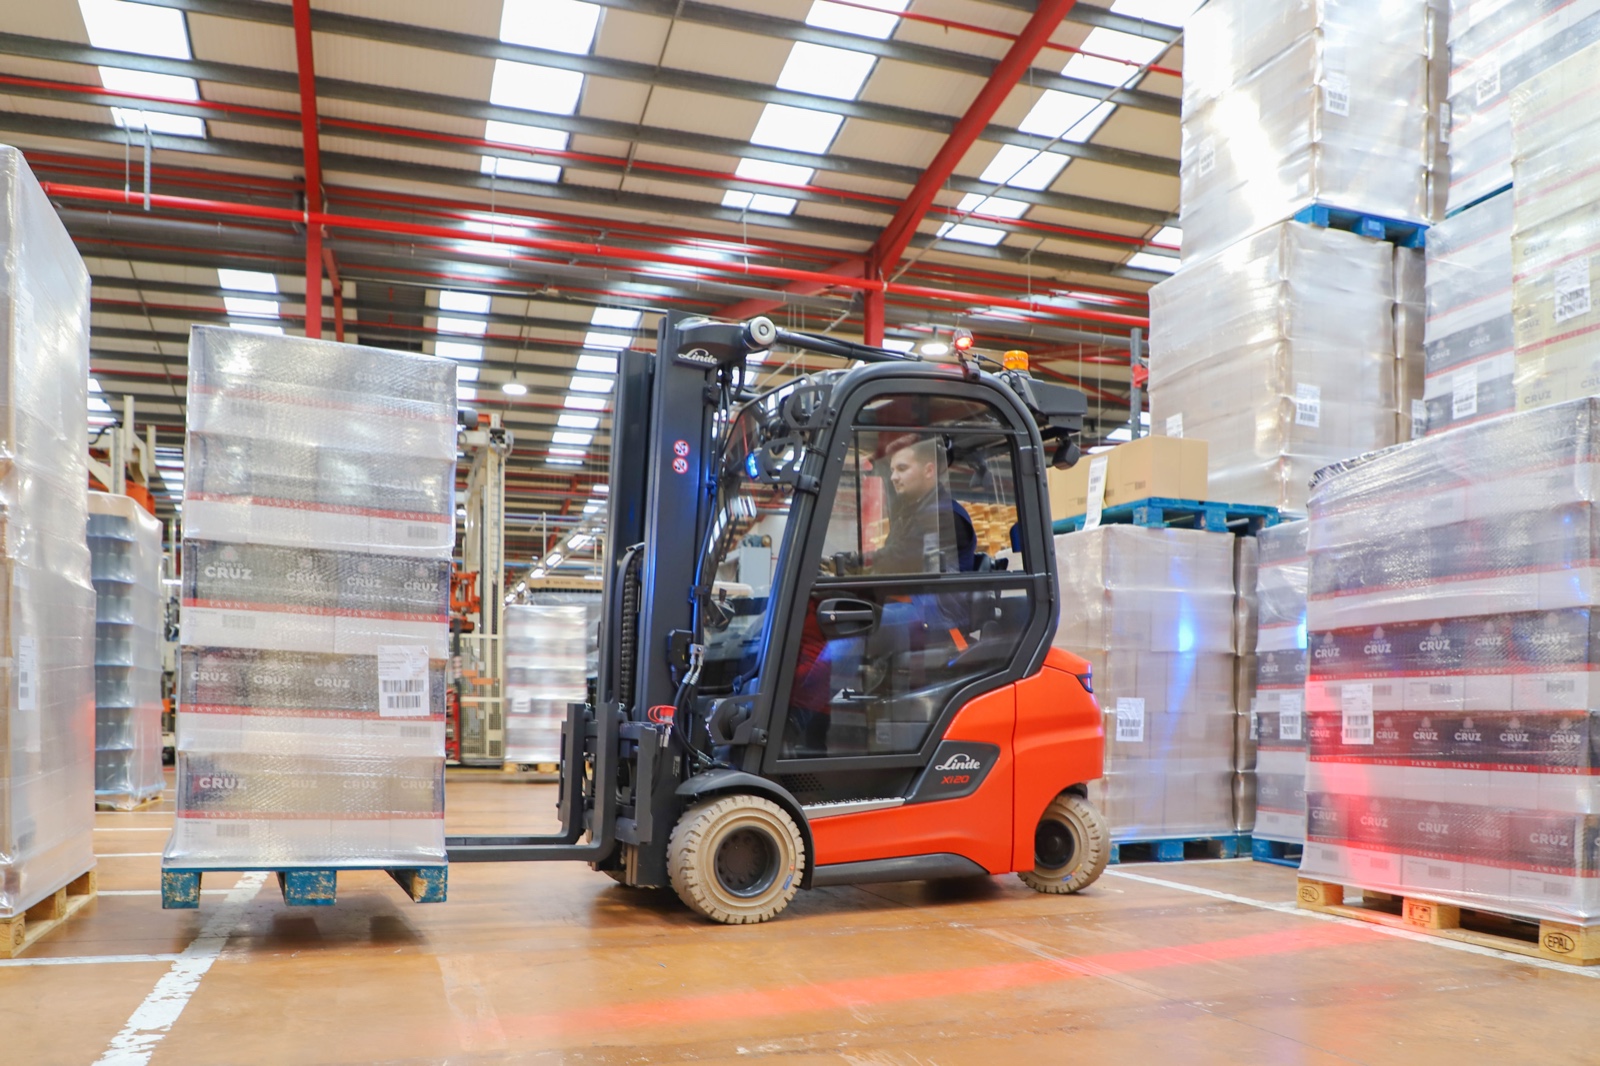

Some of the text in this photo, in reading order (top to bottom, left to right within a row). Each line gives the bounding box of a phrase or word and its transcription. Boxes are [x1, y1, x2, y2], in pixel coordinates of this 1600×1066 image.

[1523, 239, 1551, 256] CRUZ
[1518, 319, 1541, 331] CRUZ
[1469, 334, 1491, 348] CRUZ
[678, 348, 718, 365] Linde
[1431, 349, 1450, 361] CRUZ
[1580, 377, 1600, 389] CRU
[1524, 390, 1551, 405] CRUZ
[395, 513, 431, 521] TAWNY
[204, 566, 253, 580] CRUZ
[286, 571, 324, 583] CRUZ
[347, 576, 382, 588] CRUZ
[404, 581, 439, 592] CRUZ
[209, 600, 250, 609] TAWNY
[347, 608, 385, 618] TAWNY
[1475, 636, 1502, 647] CRUZ
[1532, 631, 1570, 645] CRUZ
[1364, 643, 1392, 654] CRUZ
[1419, 639, 1450, 651] CRUZ
[1315, 647, 1340, 658] CRUZ
[1261, 665, 1279, 673] CRUZ
[190, 671, 229, 682] CRUZ
[254, 675, 292, 686] CRUZ
[314, 678, 350, 688] CRUZ
[1310, 729, 1331, 738] CRUZ
[1376, 731, 1399, 740] CRUZ
[1413, 732, 1438, 741] CRUZ
[1454, 732, 1482, 741] CRUZ
[1499, 733, 1529, 742] CRUZ
[1550, 734, 1581, 744] CRUZ
[935, 753, 980, 771] Linde
[1452, 762, 1481, 770] TAWNY
[1497, 764, 1529, 772] TAWNY
[1547, 766, 1580, 774] TAWNY
[199, 777, 247, 791] CRUZ
[343, 780, 377, 789] CRUZ
[400, 780, 435, 790] CRUZ
[941, 775, 970, 784] Xi20
[1312, 810, 1338, 821] CRUZ
[1360, 816, 1389, 828] CRUZ
[1417, 822, 1449, 835] CRUZ
[1529, 832, 1569, 847] CRUZ
[1530, 865, 1563, 873] TAWNY
[1547, 935, 1570, 951] EPAL
